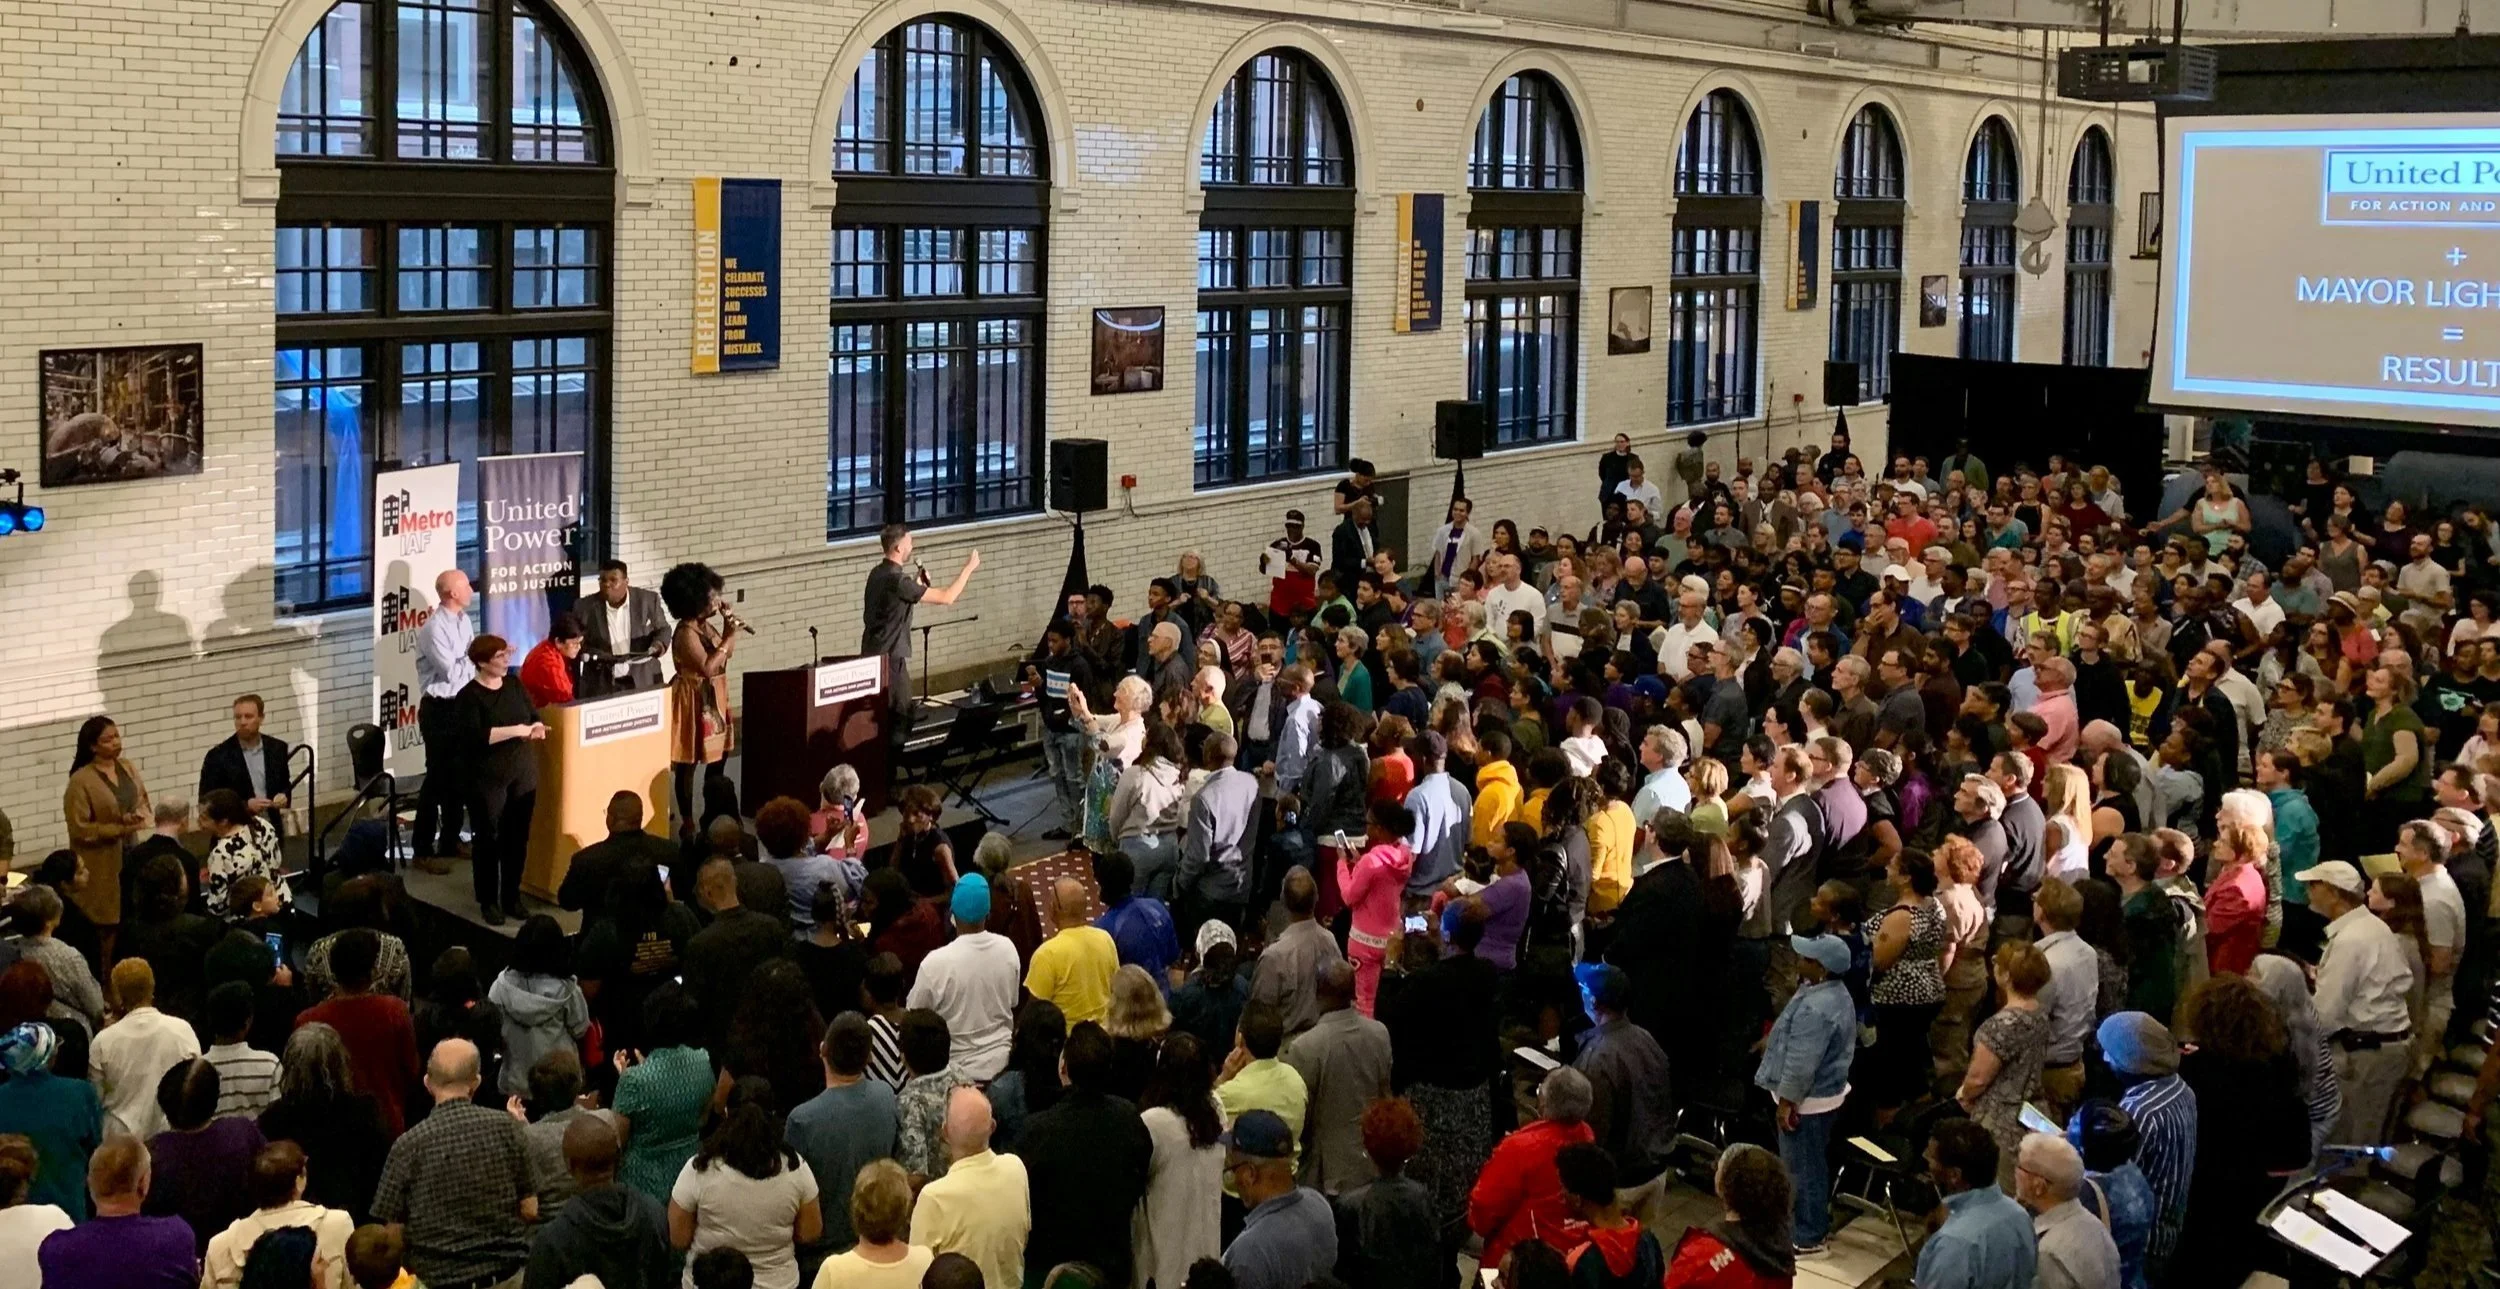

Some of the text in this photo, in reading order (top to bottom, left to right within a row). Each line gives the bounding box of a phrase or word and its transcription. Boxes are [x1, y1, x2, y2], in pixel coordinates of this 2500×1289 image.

[2346, 160, 2461, 185] United
[2350, 200, 2496, 212] FOR ACTION AND
[725, 257, 737, 269] WE
[725, 271, 765, 283] CELEBRATE
[697, 231, 716, 356] REFLECTION
[725, 286, 767, 298] SUCCESSES
[2298, 276, 2500, 308] MAYOR LIGH
[724, 301, 740, 312] AND
[724, 314, 748, 326] LEARN
[724, 329, 746, 340] FROM
[2383, 355, 2500, 387] RESULT
[401, 509, 454, 533] Metro
[484, 494, 575, 524] United
[400, 530, 432, 557] IAF
[484, 526, 577, 553] Power
[490, 560, 573, 579] FOR ACTION
[488, 575, 575, 595] AND JUSTICE
[399, 606, 434, 632] Met
[399, 629, 417, 654] IA
[398, 725, 424, 751] IA
